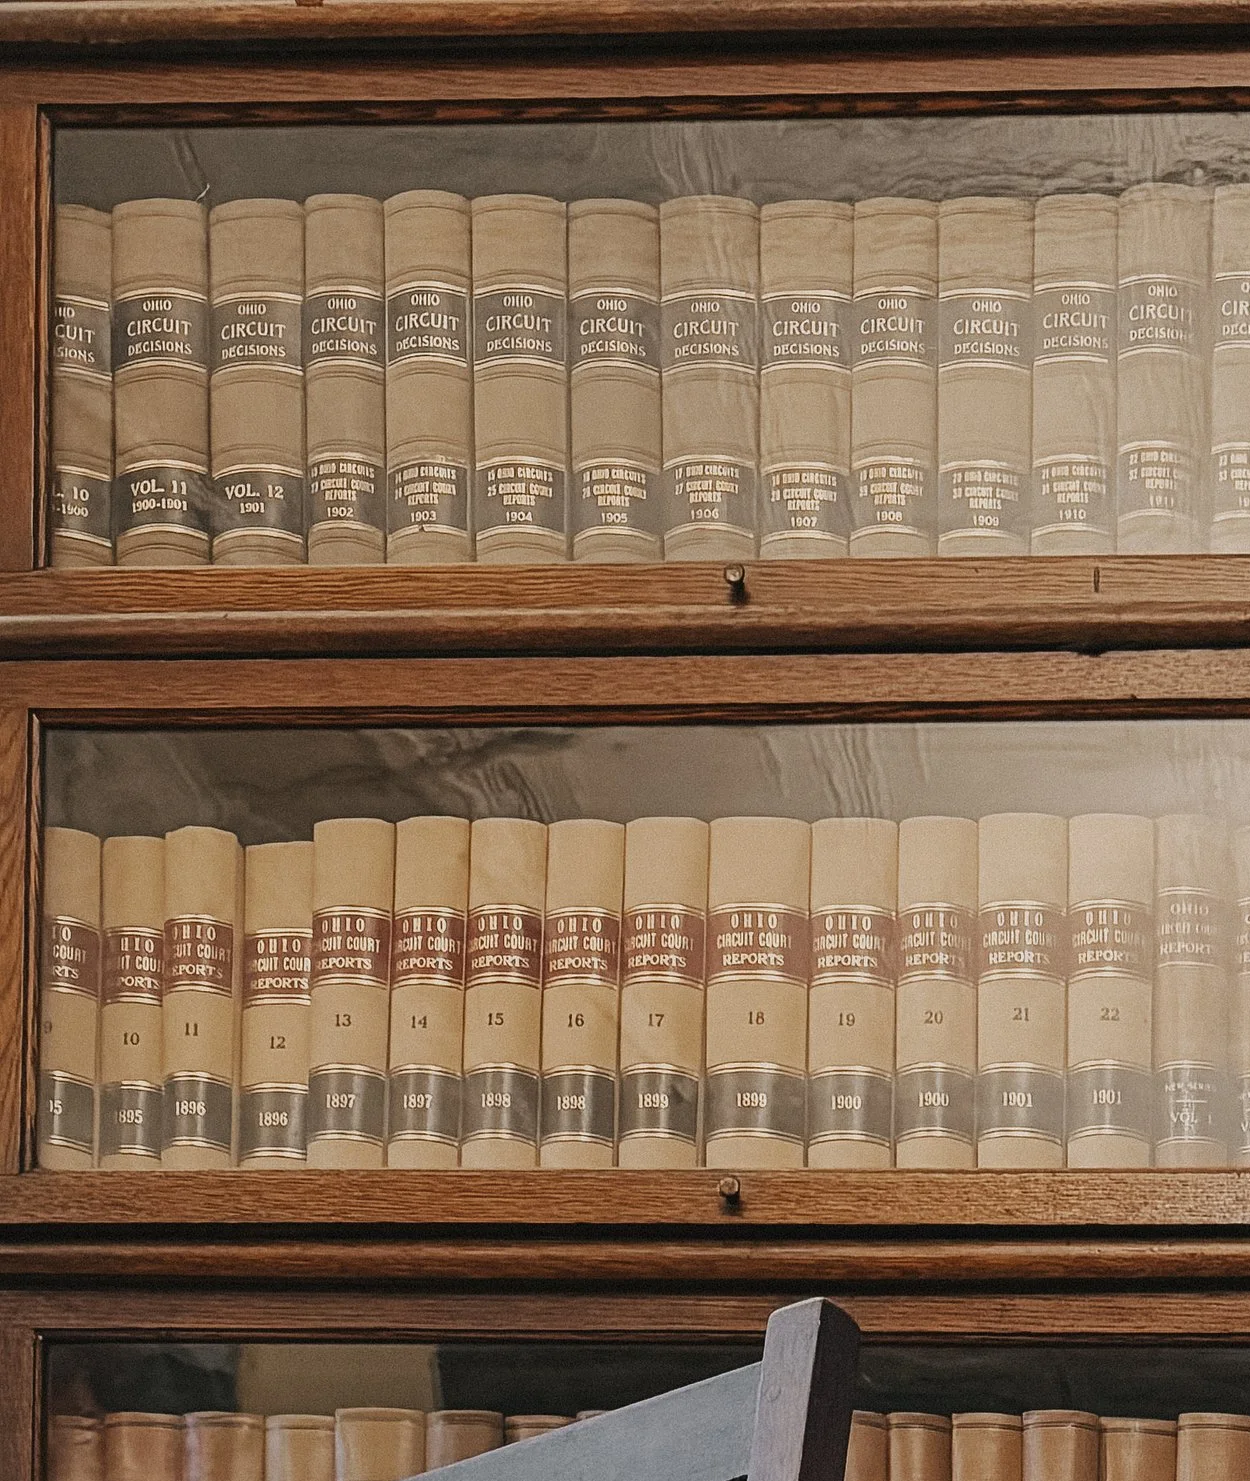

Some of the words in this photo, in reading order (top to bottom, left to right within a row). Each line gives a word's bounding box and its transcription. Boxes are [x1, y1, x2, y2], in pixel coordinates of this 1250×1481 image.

[1148, 285, 1178, 298] OHIO
[143, 300, 172, 312] OHIO
[327, 298, 356, 310] OHIO
[411, 294, 440, 306] OHIO
[504, 296, 532, 308] OHIO
[597, 300, 627, 312] OHIO
[691, 302, 720, 313] OHIO
[878, 298, 908, 310] OHIO
[972, 301, 1002, 313] OHIO
[1062, 294, 1090, 306] OHIO
[238, 304, 266, 315] OHIO
[791, 302, 820, 314] OHIO
[127, 318, 192, 336] CIRCUIT
[311, 317, 376, 336] CIRCUIT
[395, 312, 460, 332] CIRCUIT
[486, 316, 552, 334] CIRCUIT
[580, 318, 646, 338] CIRCUIT
[860, 316, 926, 336] CIRCUIT
[954, 319, 1020, 338] CIRCUIT
[1043, 312, 1109, 330] CIRCUIT
[221, 322, 286, 340] CIRCUIT
[674, 320, 740, 339] CIRCUIT
[773, 320, 840, 338] CIRCUIT
[128, 341, 192, 356] DECISIONS
[312, 340, 377, 356] DECISIONS
[396, 335, 460, 351] DECISIONS
[487, 336, 552, 352] DECISIONS
[581, 341, 646, 357] DECISIONS
[774, 343, 840, 358] DECISIONS
[861, 340, 925, 355] DECISIONS
[954, 342, 1020, 358] DECISIONS
[1043, 336, 1109, 350] DECISIONS
[221, 344, 286, 360] DECISIONS
[674, 343, 740, 359] DECISIONS
[131, 480, 164, 497] VOL.
[172, 481, 188, 496] 11
[225, 484, 260, 501] VOL.
[268, 484, 284, 500] 12
[240, 502, 265, 514] 1901
[327, 506, 354, 518] 1902
[690, 508, 719, 520] 1906
[410, 510, 437, 522] 1903
[506, 510, 533, 523] 1904
[601, 512, 628, 524] 1905
[790, 516, 818, 528] 1907
[876, 510, 903, 522] 1908
[972, 514, 1000, 527] 1909
[321, 917, 365, 934] OHIO
[402, 917, 447, 934] OHIO
[478, 916, 522, 932] OHIO
[557, 917, 602, 934] OHIO
[636, 914, 680, 930] OHIO
[731, 914, 778, 929] OHIO
[826, 916, 872, 932] OHIO
[912, 912, 958, 928] OHIO
[997, 911, 1044, 926] OHIO
[1085, 910, 1131, 926] OHIO
[257, 938, 301, 954] OHIO
[346, 936, 380, 954] COURT
[428, 936, 461, 954] COURT
[504, 934, 538, 952] COURT
[584, 936, 618, 954] COURT
[717, 932, 754, 950] CIRCUIT
[758, 932, 792, 950] COURT
[198, 944, 232, 963] COURT
[628, 954, 687, 968] REPORTS
[723, 952, 784, 966] REPORTS
[818, 954, 878, 968] REPORTS
[472, 954, 530, 969] REPORTS
[550, 957, 608, 971] REPORTS
[334, 1014, 352, 1027] 13
[487, 1012, 504, 1026] 15
[567, 1014, 584, 1028] 16
[648, 1014, 664, 1028] 17
[748, 1011, 765, 1025] 18
[838, 1012, 856, 1026] 19
[924, 1010, 944, 1024] 20
[1012, 1007, 1030, 1021] 21
[1100, 1007, 1120, 1022] 22
[184, 1022, 199, 1036] 11
[410, 1015, 428, 1029] 14
[122, 1032, 140, 1046] 10
[270, 1036, 286, 1050] 12
[326, 1094, 356, 1108] 1897
[403, 1094, 434, 1109] 1897
[481, 1093, 512, 1108] 1898
[557, 1094, 586, 1110] 1898
[638, 1093, 669, 1108] 1899
[736, 1092, 768, 1108] 1899
[831, 1094, 862, 1110] 1900
[918, 1092, 950, 1108] 1900
[1002, 1092, 1033, 1108] 1901
[1092, 1090, 1122, 1104] 1901
[175, 1100, 206, 1116] 1896
[258, 1112, 288, 1127] 1896
